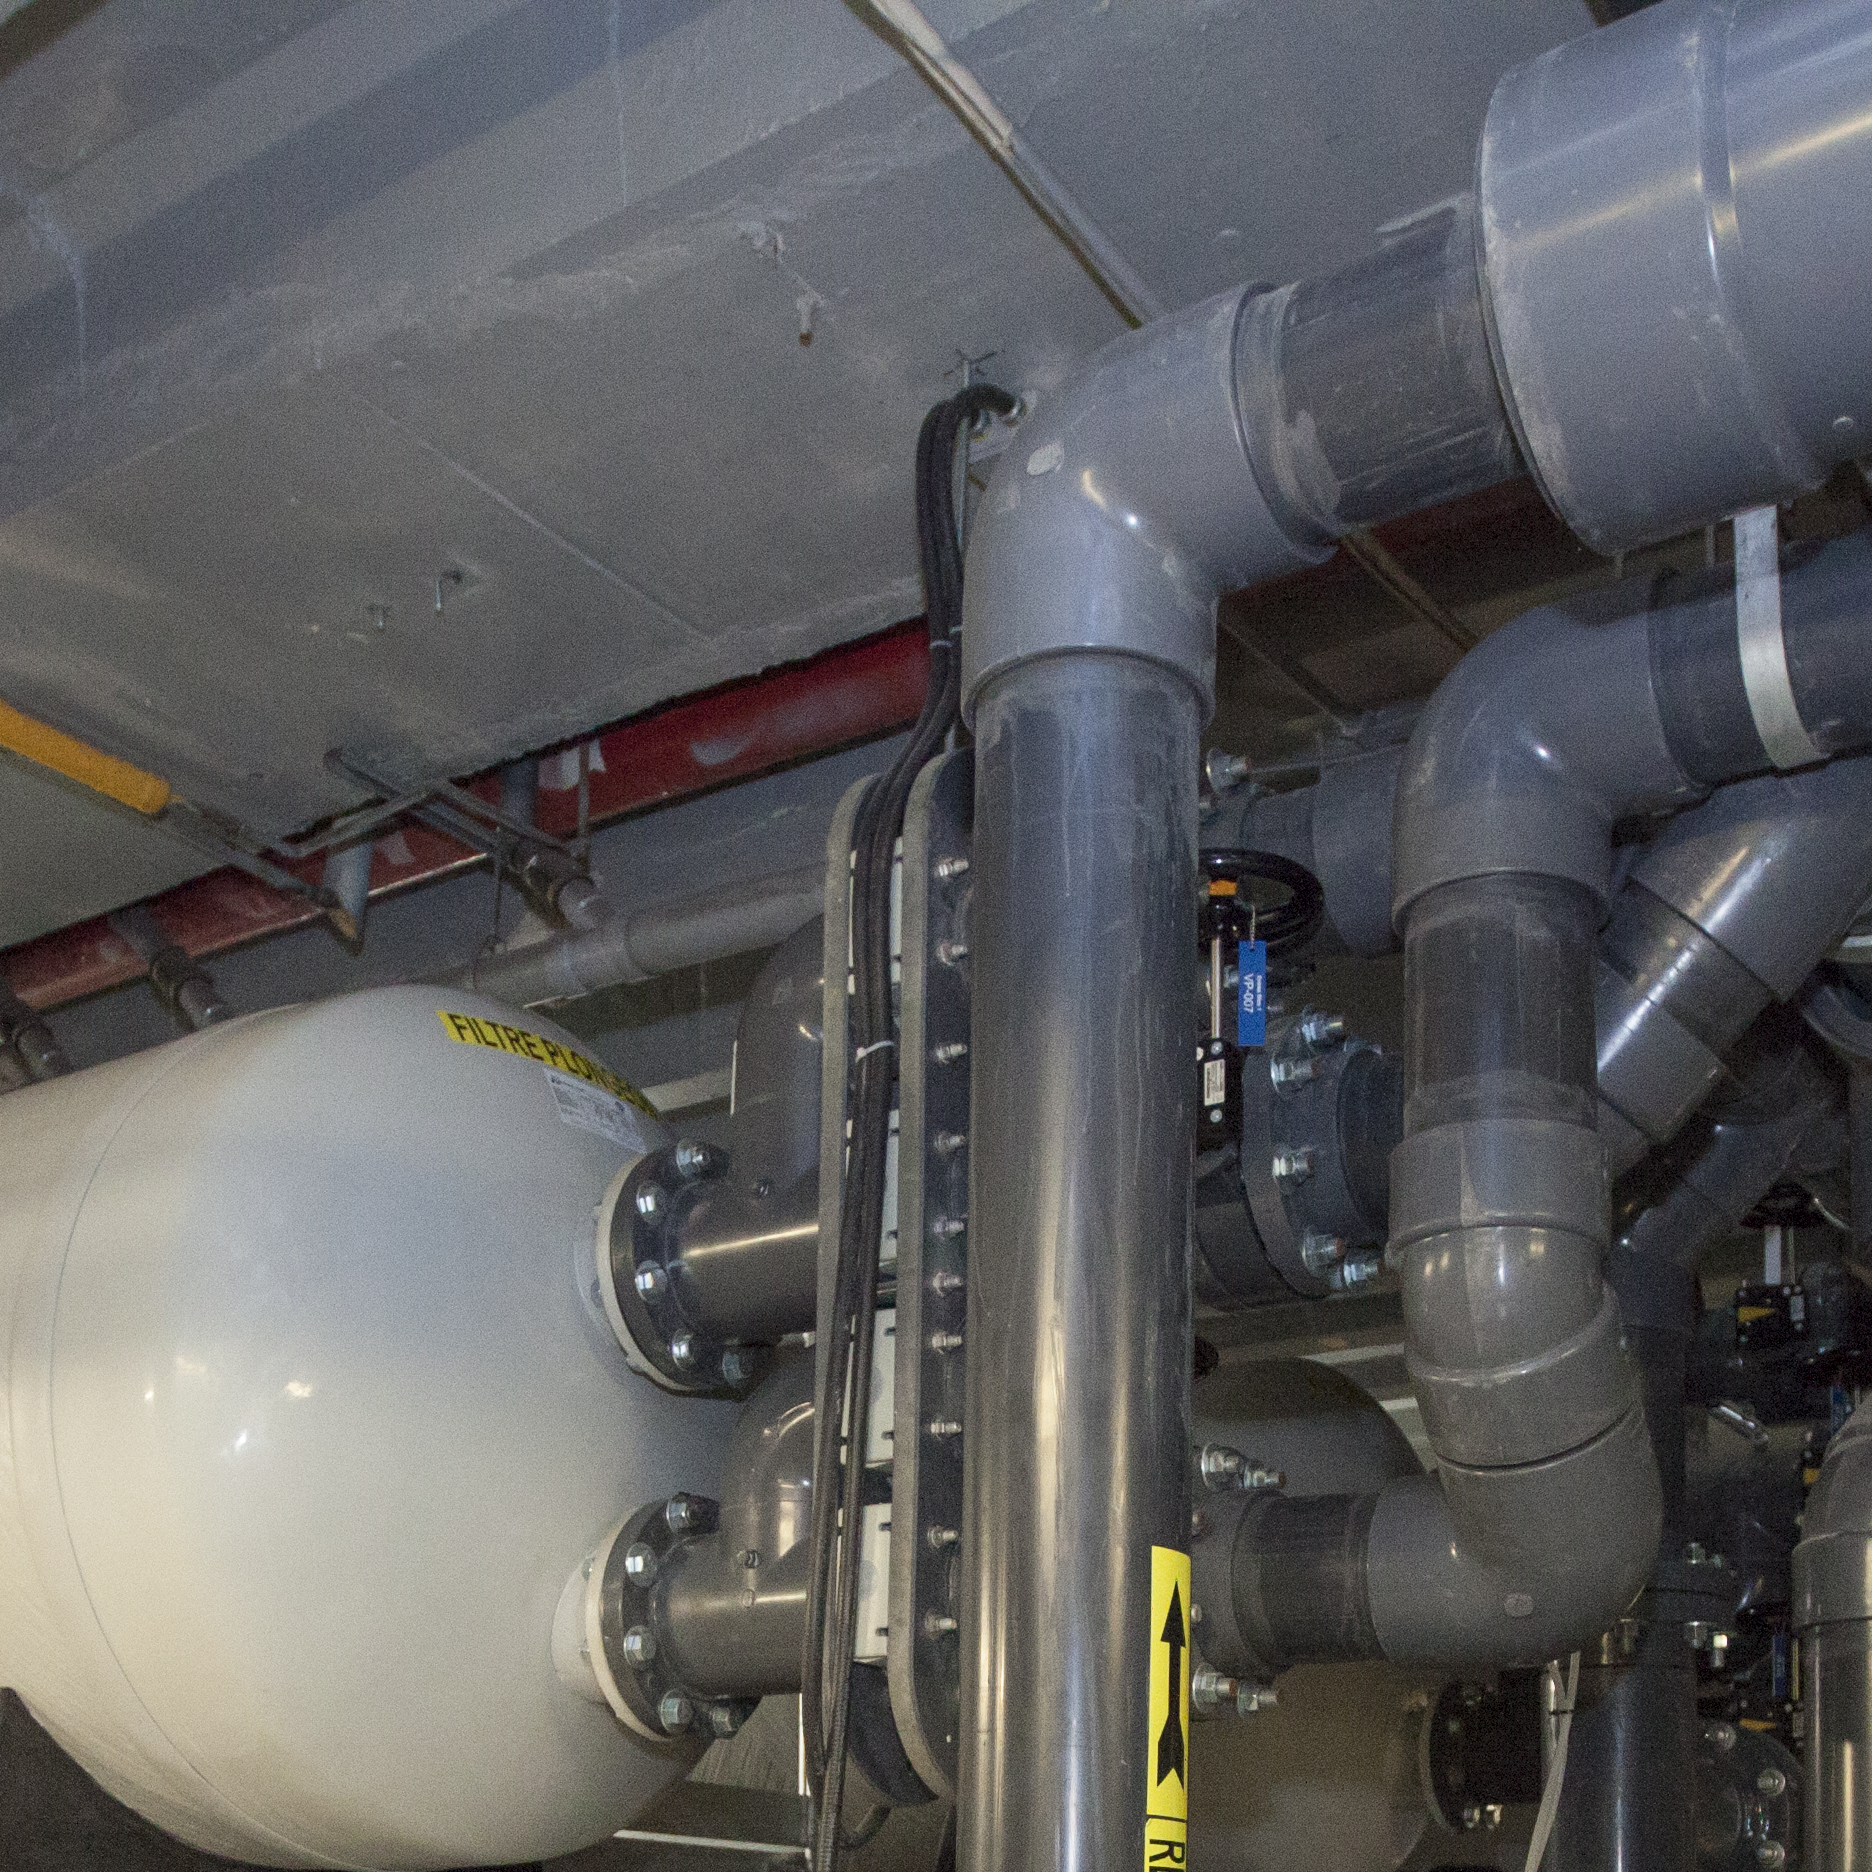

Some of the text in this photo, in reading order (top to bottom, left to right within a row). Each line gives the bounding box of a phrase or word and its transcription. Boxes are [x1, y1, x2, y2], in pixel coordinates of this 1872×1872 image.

[1243, 972, 1254, 1013] VP-007
[447, 1012, 544, 1060] FILTRE
[540, 1037, 659, 1120] PLON
